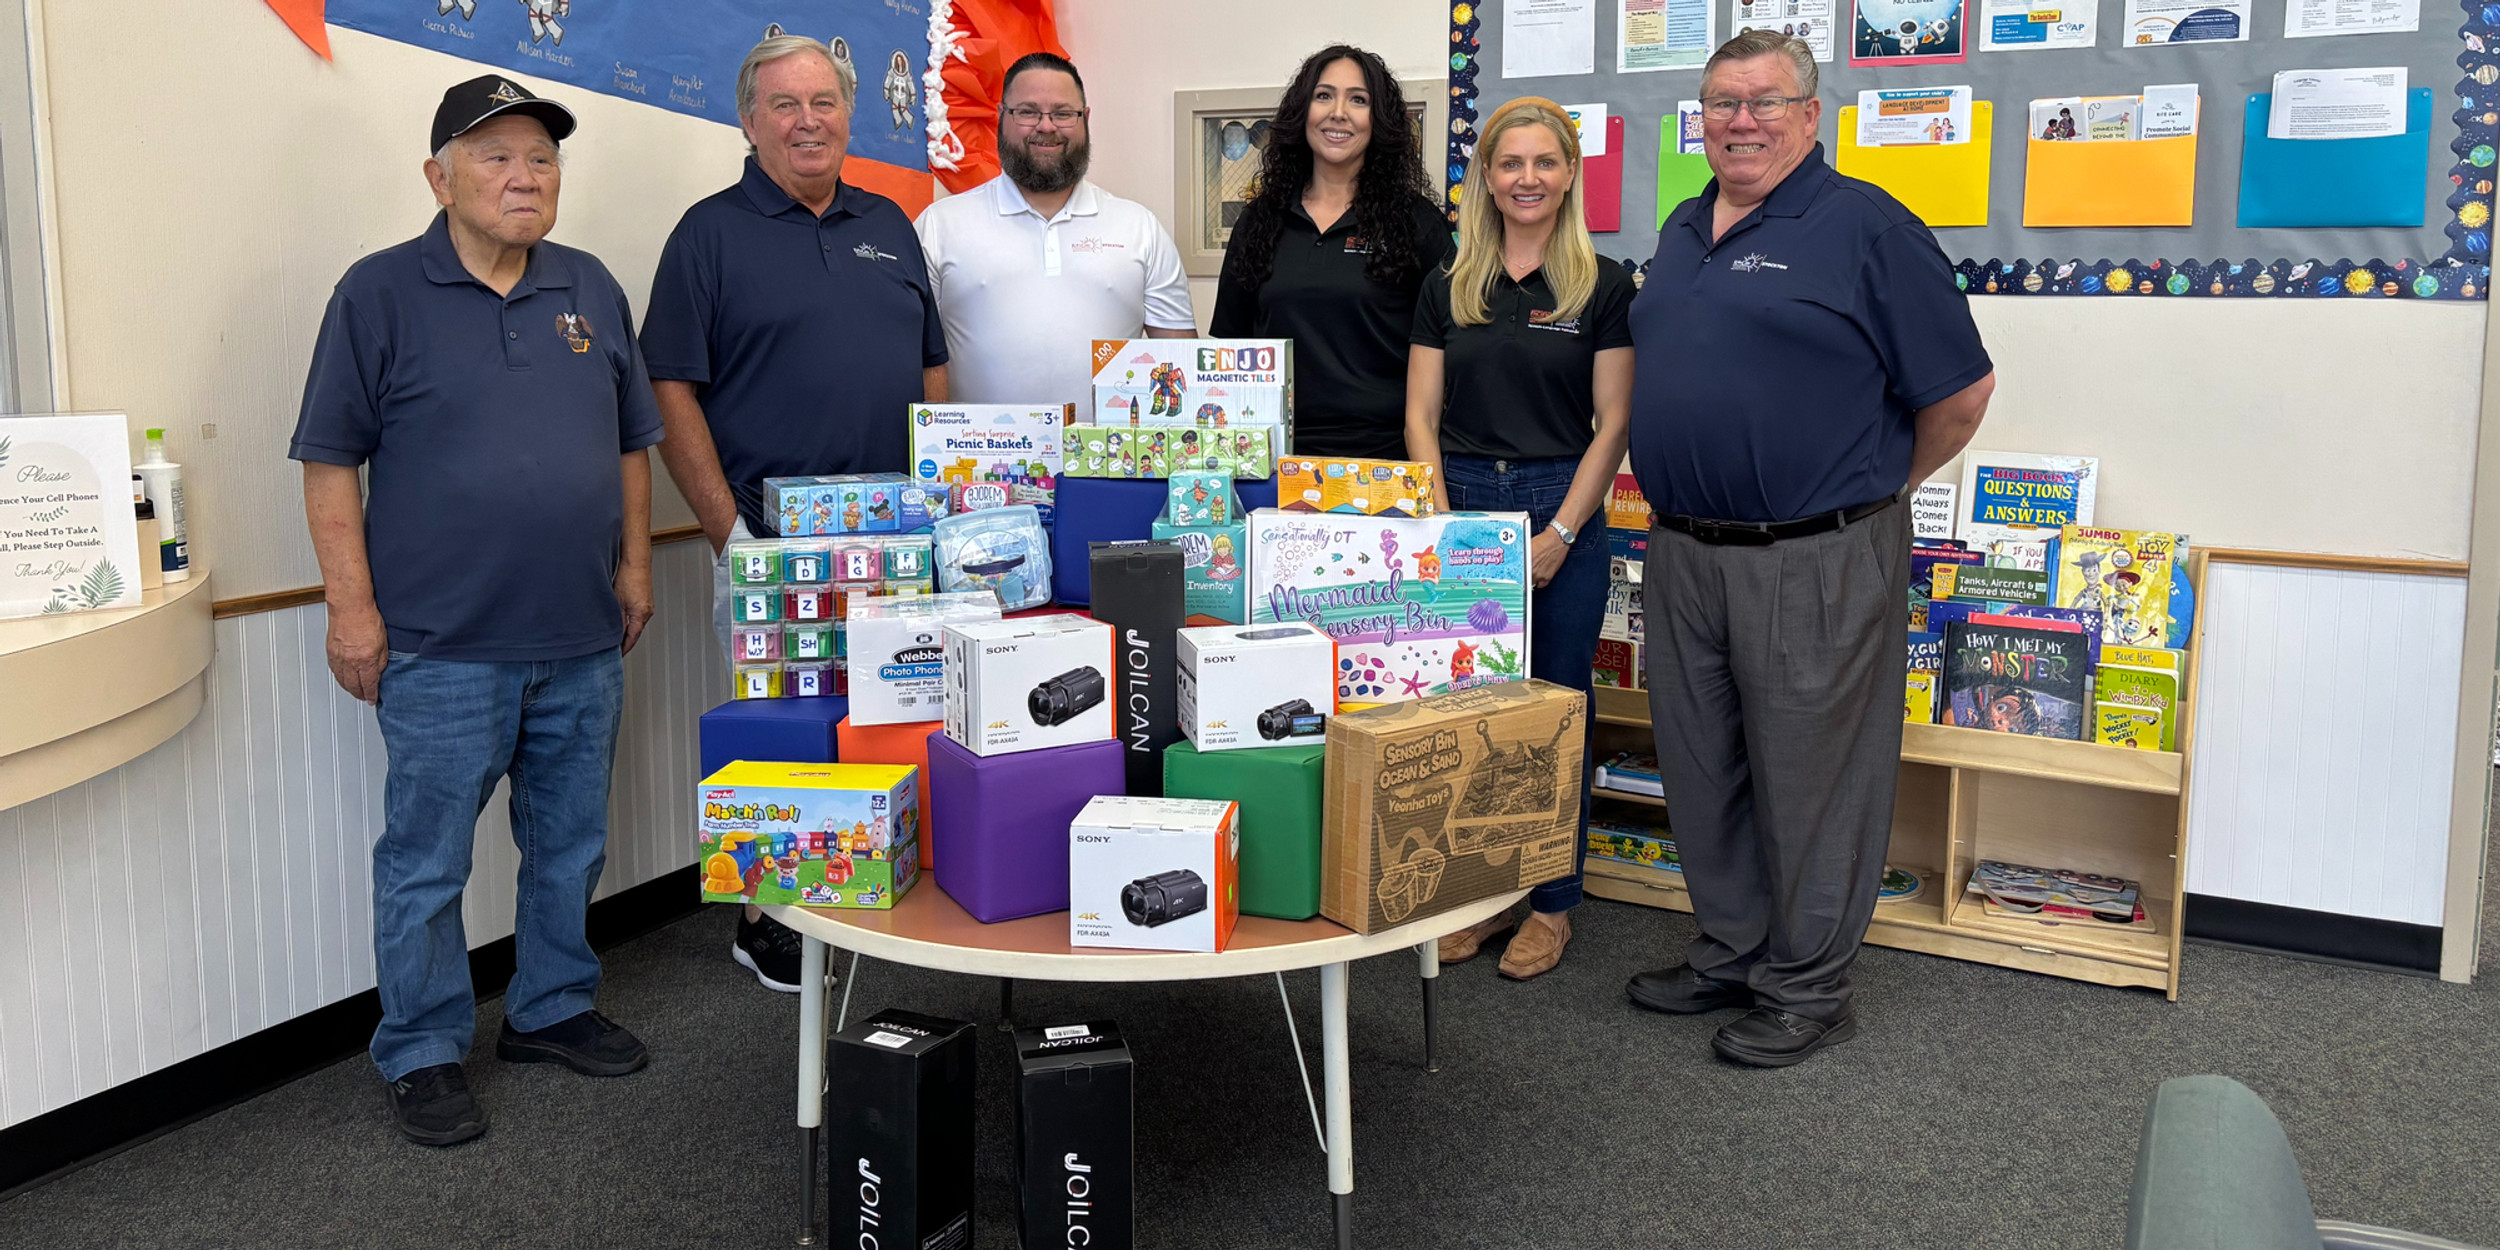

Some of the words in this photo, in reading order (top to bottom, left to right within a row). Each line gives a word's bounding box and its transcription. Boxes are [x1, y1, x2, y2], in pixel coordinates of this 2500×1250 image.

[1094, 342, 1114, 362] 100
[1198, 347, 1275, 371] FNJO
[1197, 374, 1249, 383] MAGNETIC
[1251, 374, 1276, 383] TILES
[934, 410, 965, 418] Learning
[1044, 412, 1060, 425] 3+
[962, 429, 986, 440] Sorting
[988, 430, 1016, 439] Surprise
[946, 438, 984, 449] Picnic
[987, 438, 1033, 449] Baskets
[17, 465, 72, 483] Please
[1993, 469, 2018, 480] BIG
[2022, 472, 2066, 484] BOOK
[1984, 480, 2073, 500] QUESTIONS
[21, 496, 45, 504] Your
[46, 494, 64, 503] Cell
[66, 493, 99, 502] Phones
[1912, 498, 1949, 508] Always
[2020, 498, 2030, 508] &
[1914, 510, 1948, 520] Comes
[1984, 506, 2068, 525] ANSWERS
[4, 530, 24, 540] You
[25, 529, 49, 538] Need
[51, 528, 64, 536] To
[65, 527, 88, 536] Take
[1918, 523, 1948, 534] Back!
[2078, 529, 2121, 540] JUMBO
[1261, 528, 1330, 550] Sensationally
[1334, 530, 1356, 544] OT
[1502, 531, 1514, 541] 3+
[14, 542, 43, 552] Please
[43, 541, 64, 551] Step
[66, 539, 104, 548] Outside.
[2138, 539, 2170, 554] TOY
[904, 554, 910, 562] F
[1449, 548, 1472, 558] Learn
[1472, 546, 1504, 556] through
[2012, 546, 2022, 556] IF
[2025, 548, 2042, 558] YOU
[2140, 552, 2164, 560] STORY
[753, 558, 760, 566] P
[854, 556, 862, 564] K
[1448, 556, 1472, 566] hands
[2142, 559, 2158, 573] 4
[14, 560, 53, 578] Thank
[802, 568, 810, 578] D
[854, 567, 862, 576] G
[1187, 580, 1234, 594] Inventory
[1960, 576, 1988, 587] Tanks,
[1990, 578, 2026, 589] Aircraft
[2028, 582, 2034, 590] &
[1268, 568, 1407, 623] Mermaid
[1958, 586, 1998, 597] Armored
[2000, 588, 2038, 600] Vehicles
[752, 602, 762, 613] S
[803, 600, 812, 612] Z
[1403, 601, 1454, 633] Bin
[752, 636, 761, 646] H
[800, 640, 817, 650] SH
[2004, 637, 2010, 650] I
[2014, 638, 2044, 652] MET
[2045, 642, 2066, 654] MY
[986, 645, 1018, 655] SONY
[900, 650, 943, 664] Webbe
[1204, 656, 1236, 664] SONY
[1593, 652, 1628, 668] OSE!
[2114, 650, 2134, 662] BLUE
[2137, 652, 2154, 664] HAT,
[884, 667, 912, 676] Photo
[1958, 648, 2070, 684] MONSTER
[753, 679, 762, 691] L
[803, 677, 815, 688] R
[2120, 674, 2159, 686] DIARY
[1126, 628, 1151, 752] JOILCAN
[2108, 690, 2148, 706] Wimpy
[2149, 693, 2169, 709] Kid
[988, 720, 1010, 728] 4K
[1206, 720, 1228, 728] 4K
[2103, 720, 2132, 734] WOCKET
[1386, 738, 1434, 766] SENSORY
[1435, 732, 1457, 751] BIN
[1380, 765, 1418, 789] OCEAN
[1419, 759, 1432, 778] &
[1432, 752, 1460, 772] SAND
[765, 804, 800, 823] Roll
[1076, 835, 1111, 844] SONY
[1077, 912, 1101, 920] 4K
[873, 1021, 930, 1036] JOILCAN
[1039, 1035, 1104, 1049] JOILCAN
[858, 1157, 882, 1250] JOILC
[1064, 1152, 1093, 1250] JOILC
